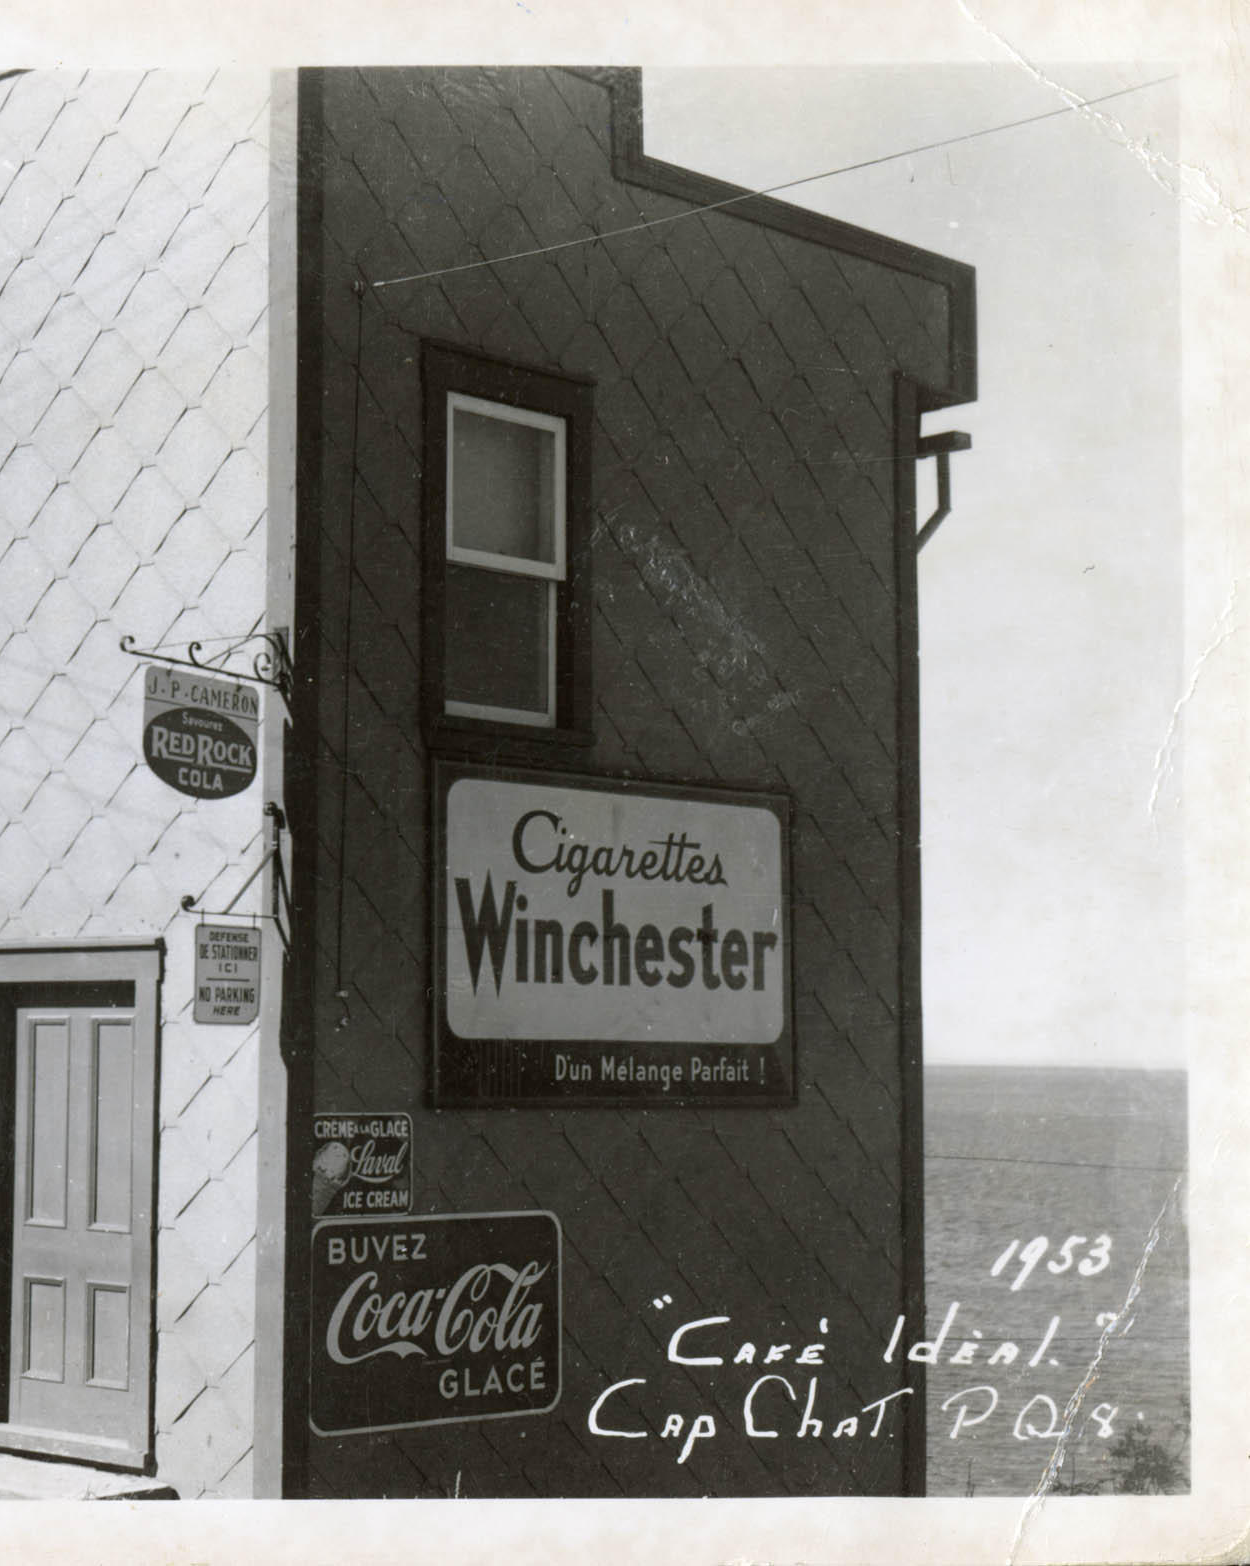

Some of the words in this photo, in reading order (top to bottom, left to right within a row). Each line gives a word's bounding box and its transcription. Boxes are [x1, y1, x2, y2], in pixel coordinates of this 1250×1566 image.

[178, 767, 224, 792] COLA
[512, 810, 729, 898] Cigarettes
[454, 868, 778, 999] Winchester
[199, 943, 209, 959] DE
[218, 962, 238, 974] ICI
[199, 987, 211, 1003] NO
[215, 987, 255, 1004] PARKING
[213, 1005, 241, 1017] HERE
[601, 1055, 683, 1091] Mélange
[691, 1056, 750, 1081] Parfait
[370, 1120, 409, 1138] GLACE
[350, 1139, 409, 1184] Laval
[343, 1191, 363, 1209] ICE
[366, 1189, 409, 1208] CREAM
[327, 1233, 428, 1265] BUVEZ
[325, 1260, 551, 1365] Coca-Cola
[438, 1355, 547, 1400] GLACÉ
